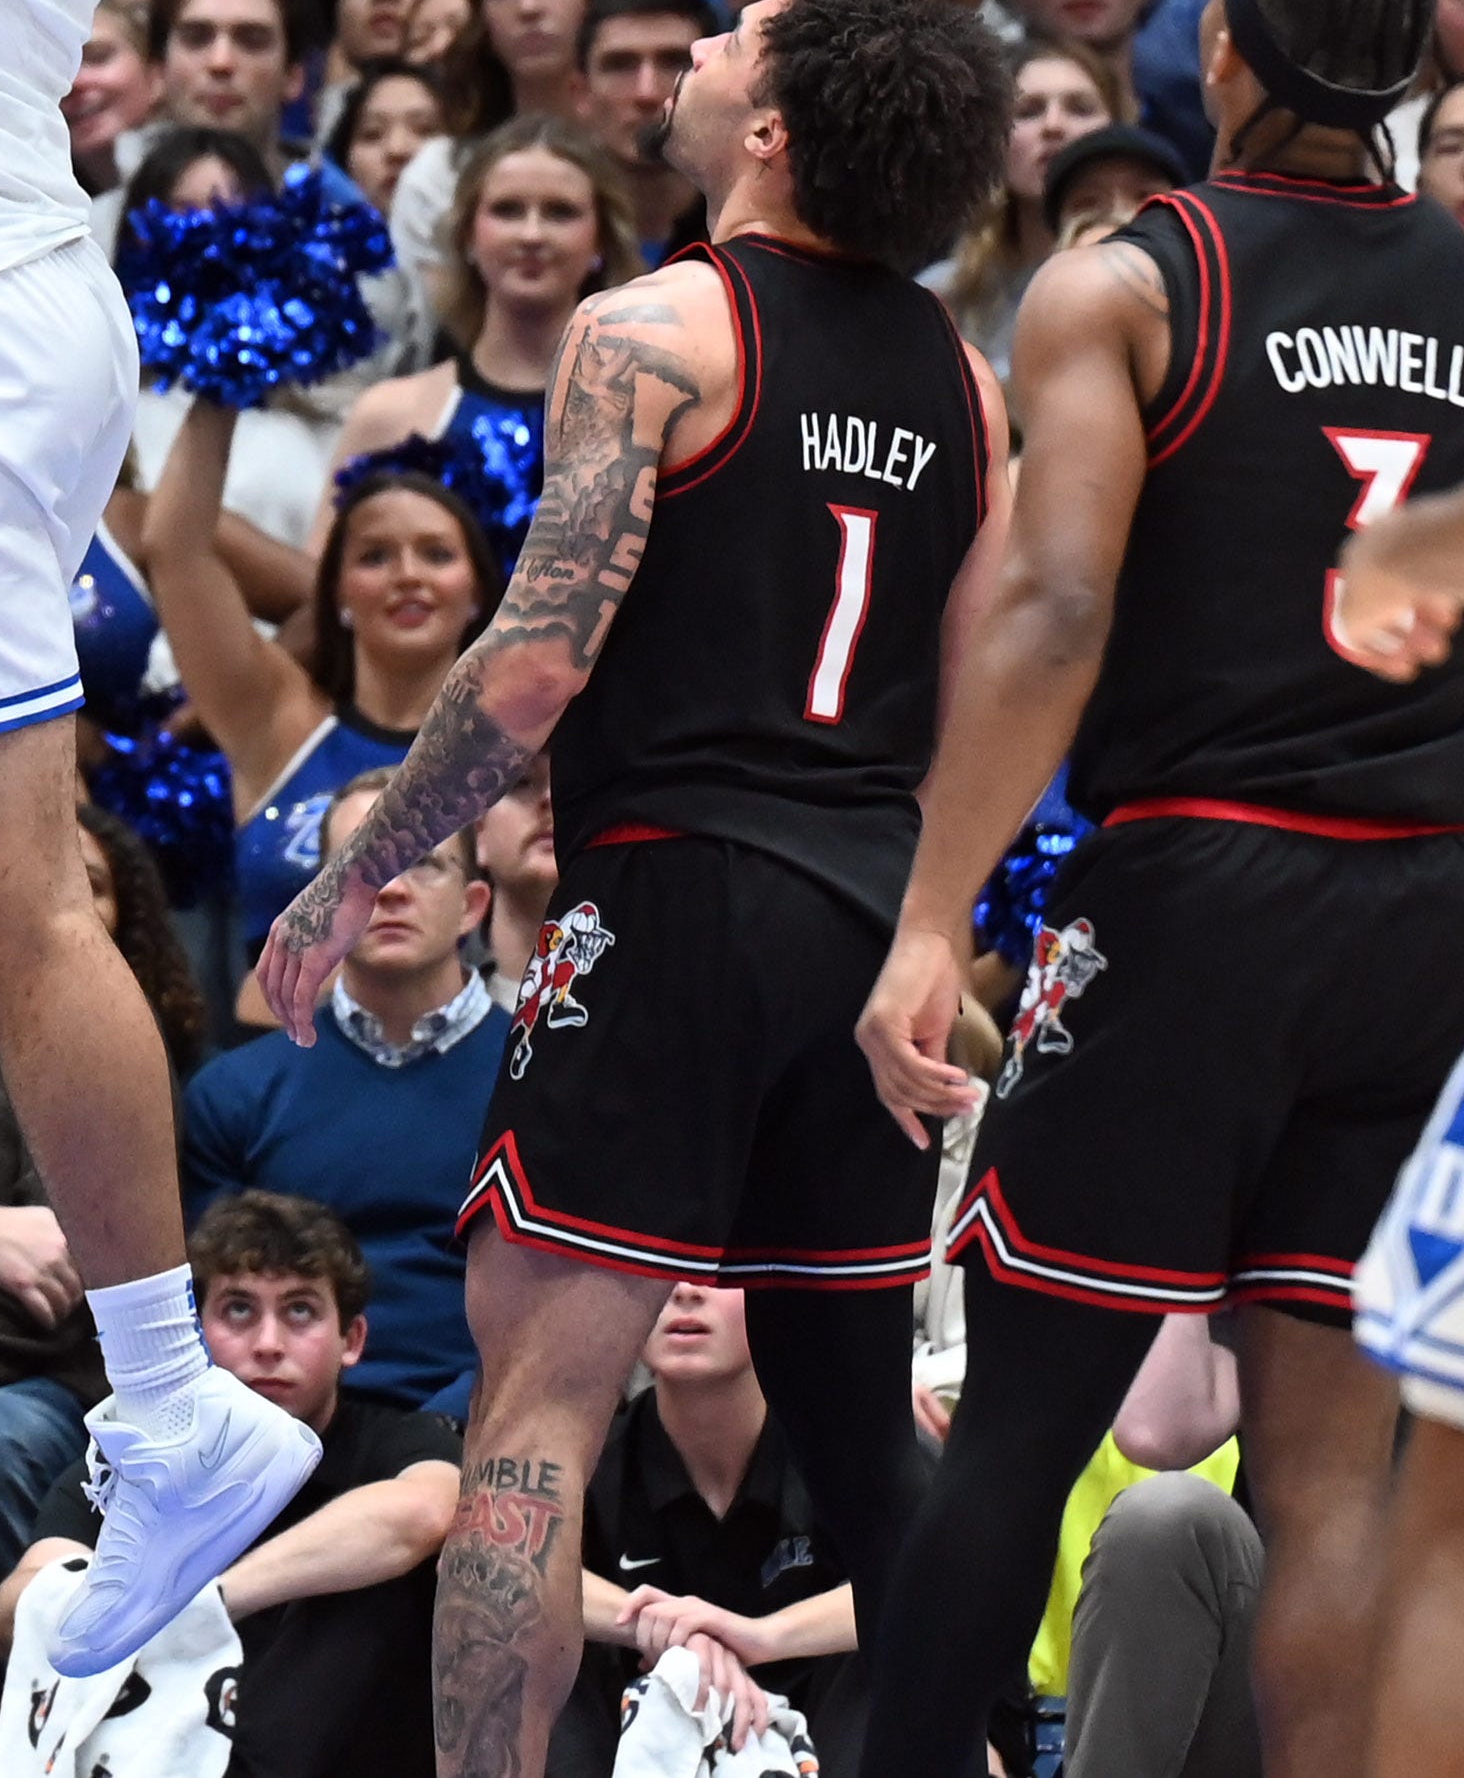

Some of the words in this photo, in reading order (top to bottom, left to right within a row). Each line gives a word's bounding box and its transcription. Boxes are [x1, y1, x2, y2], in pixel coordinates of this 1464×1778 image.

[1265, 325, 1464, 408] CONWELL
[800, 412, 936, 491] HADLEY
[803, 502, 879, 726] 1
